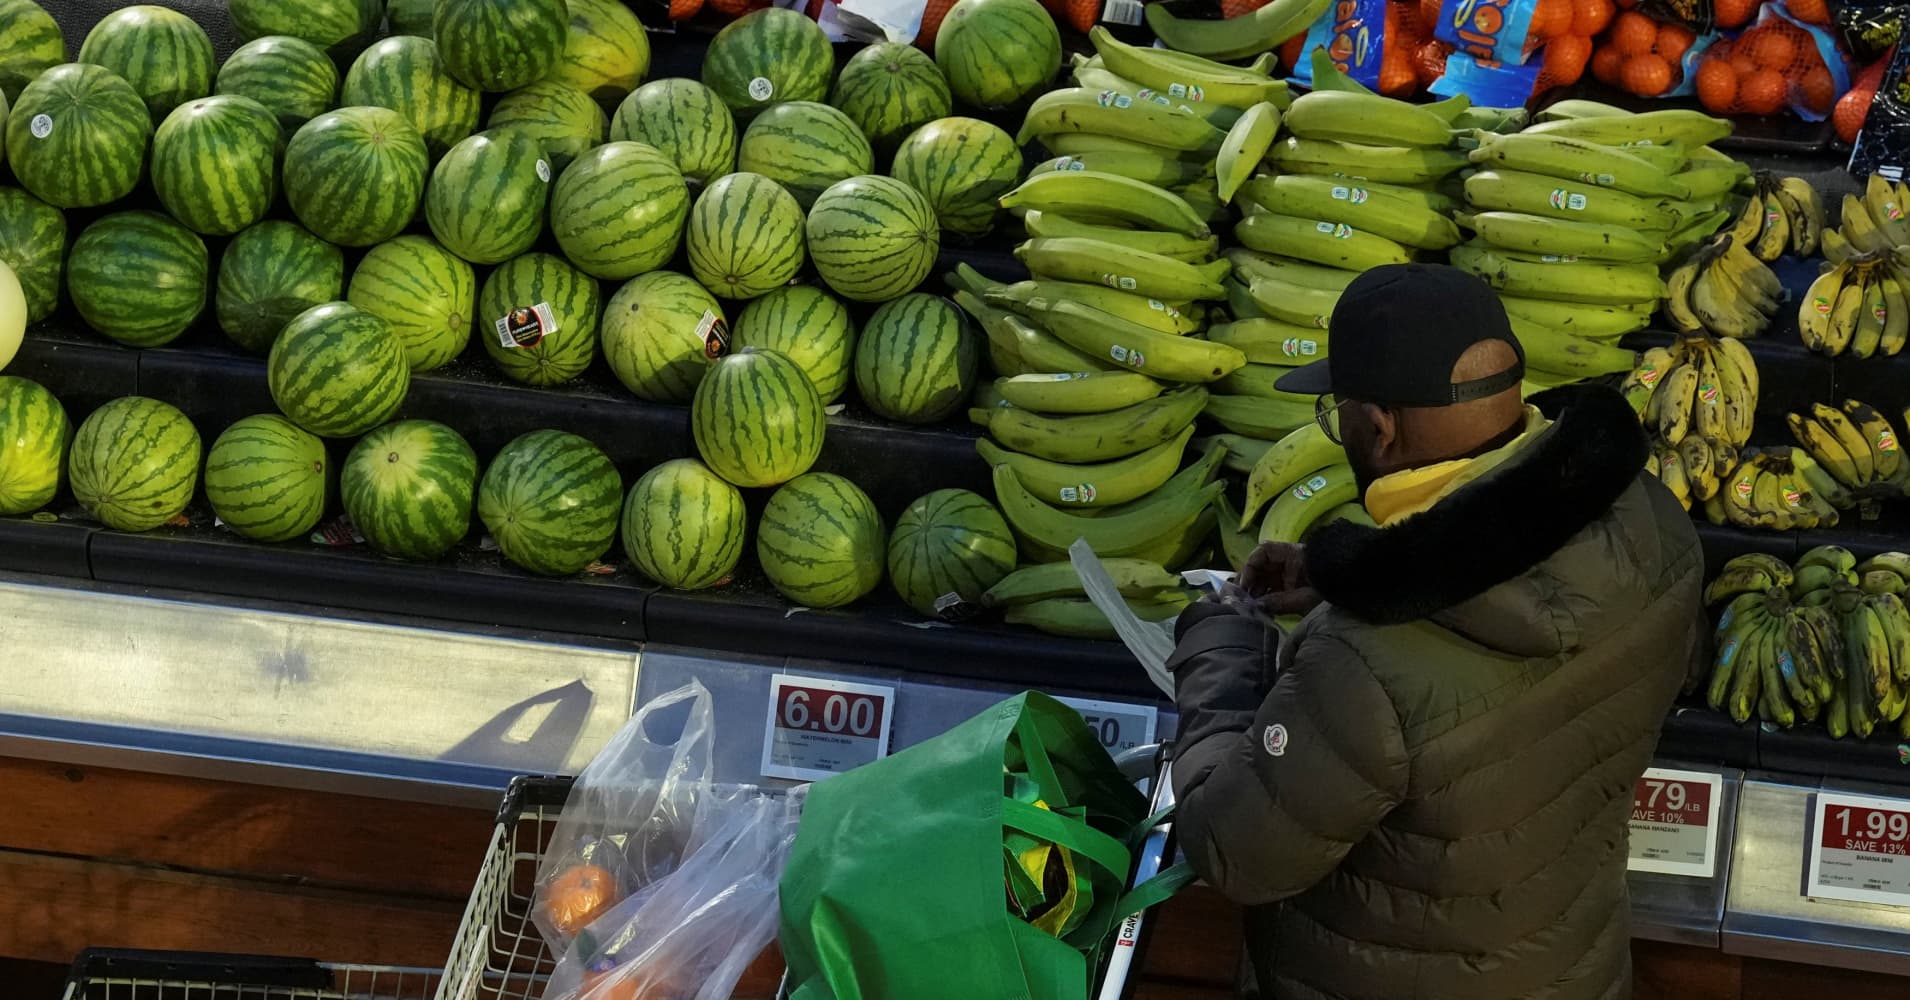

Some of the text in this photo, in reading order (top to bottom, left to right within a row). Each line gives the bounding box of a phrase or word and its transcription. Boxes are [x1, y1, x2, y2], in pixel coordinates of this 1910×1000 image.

[784, 689, 875, 735] 6.00
[1660, 812, 1685, 824] 10%
[1836, 808, 1908, 841] 1.99
[1845, 839, 1906, 855] SAVE 13%
[1856, 854, 1880, 863] BANANA
